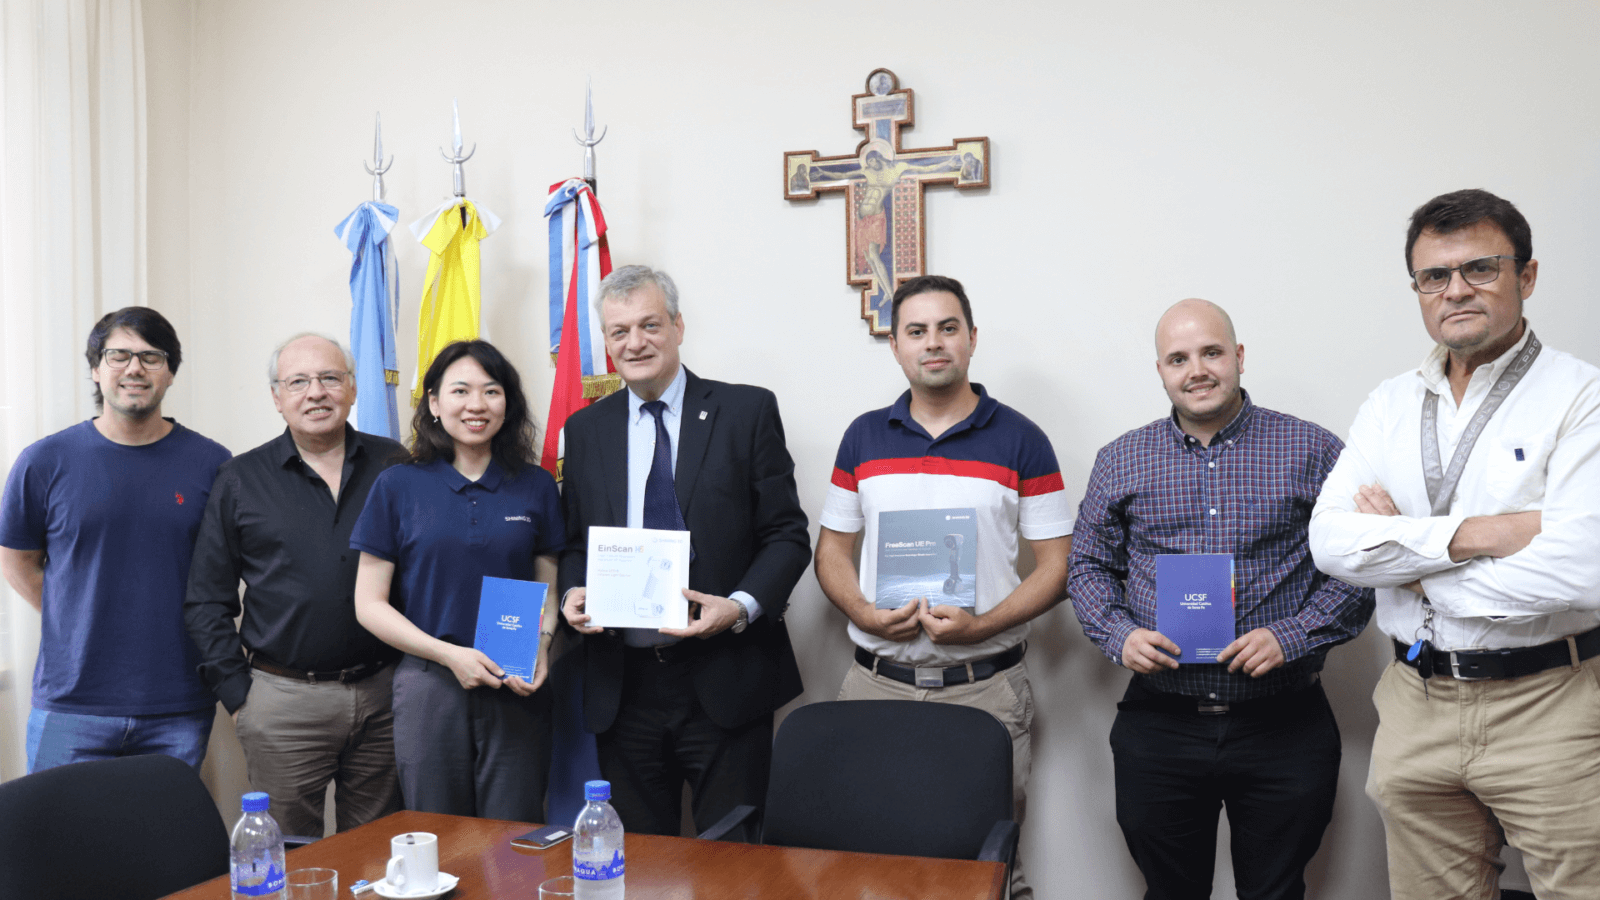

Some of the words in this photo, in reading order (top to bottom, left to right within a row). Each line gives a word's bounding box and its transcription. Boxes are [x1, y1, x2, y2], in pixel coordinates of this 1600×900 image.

[598, 544, 633, 553] EinScan
[1184, 593, 1207, 601] UCSF
[501, 615, 520, 623] UCSF
